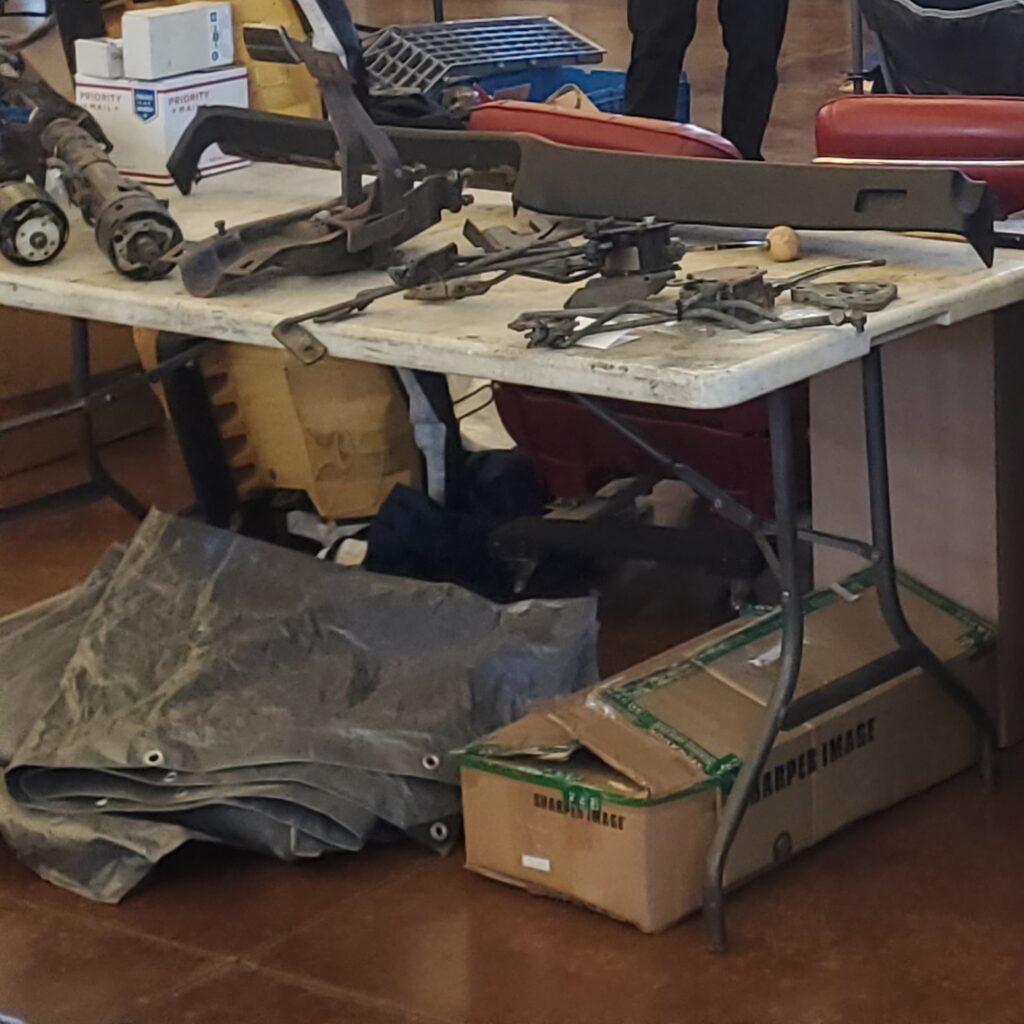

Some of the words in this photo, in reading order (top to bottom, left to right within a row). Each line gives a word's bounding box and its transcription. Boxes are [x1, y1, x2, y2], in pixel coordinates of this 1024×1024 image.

[79, 91, 122, 104] PRIORITY
[168, 91, 211, 106] PRIORITY
[821, 717, 876, 770] IMAGE
